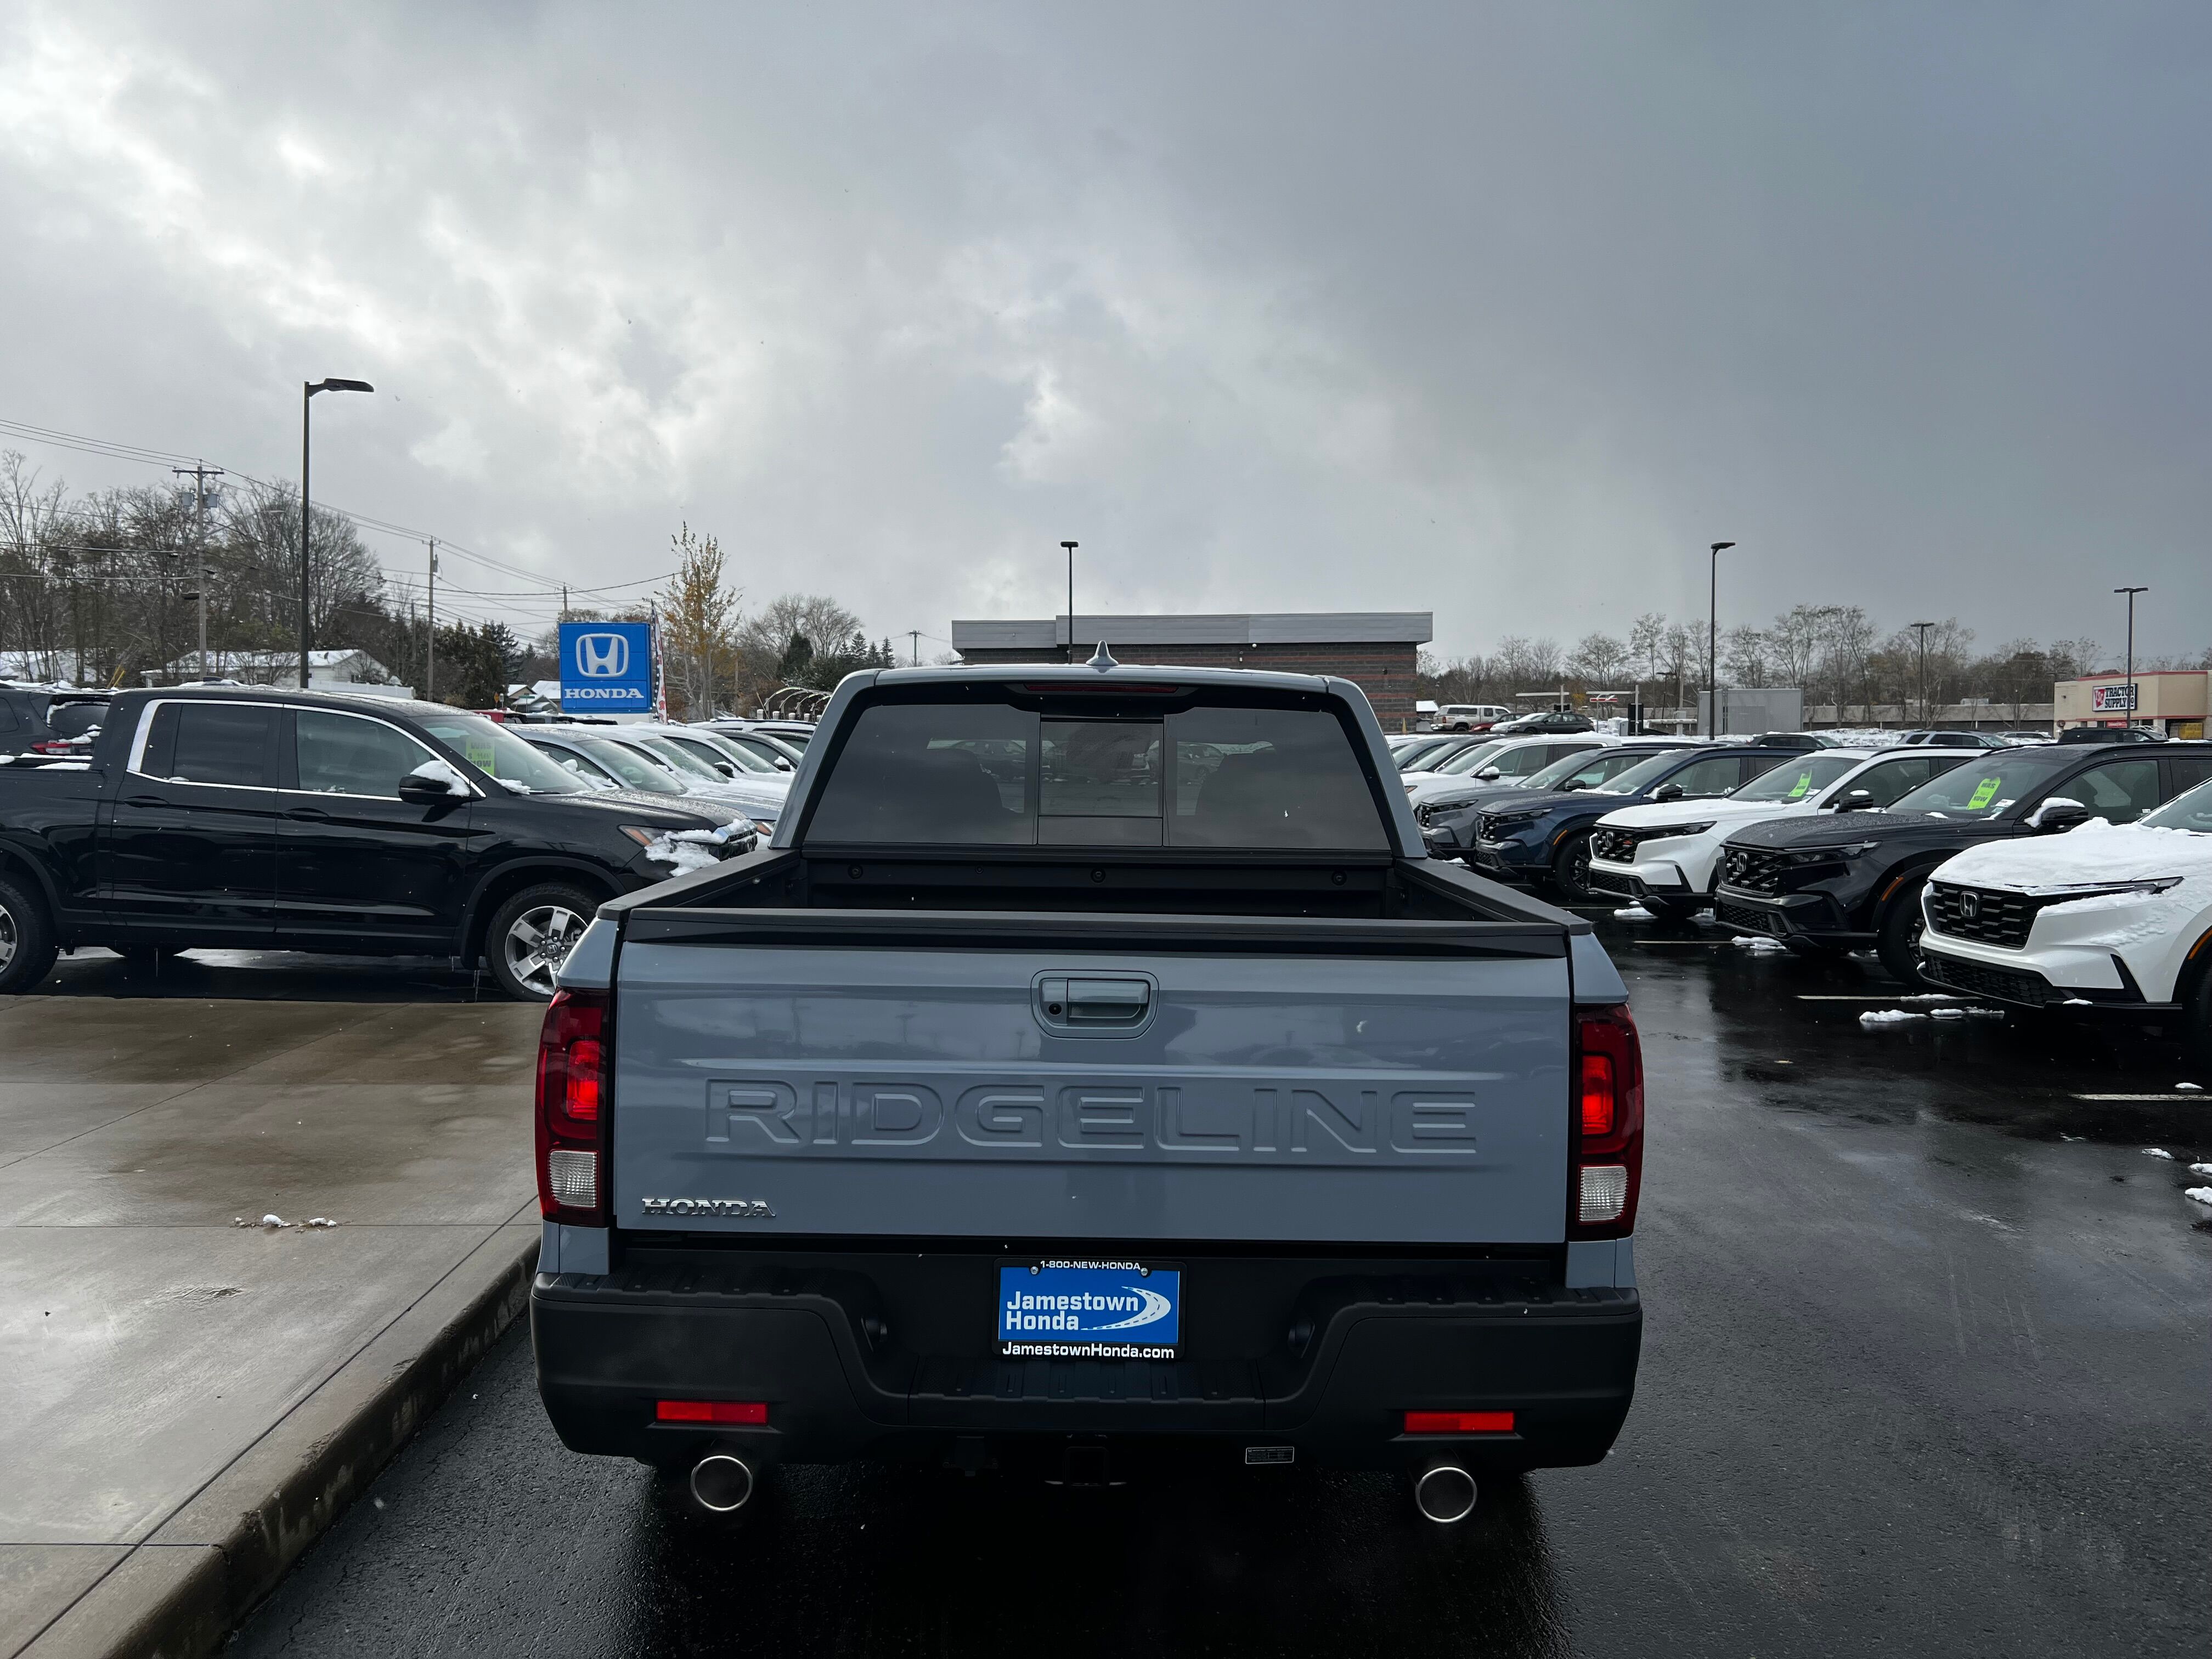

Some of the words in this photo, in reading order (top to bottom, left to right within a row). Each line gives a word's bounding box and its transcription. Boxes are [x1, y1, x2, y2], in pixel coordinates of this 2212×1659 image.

[564, 688, 645, 699] HONDA
[2105, 698, 2127, 708] SUPPLY
[705, 1077, 1477, 1154] RIDGELINE
[641, 1198, 776, 1217] HONDA
[1040, 1260, 1141, 1270] 1-800-NEW-HONDA
[1006, 1291, 1138, 1311] Jamestown
[1006, 1310, 1079, 1331] Honda
[1002, 1341, 1174, 1359] JamestownHonda.com
